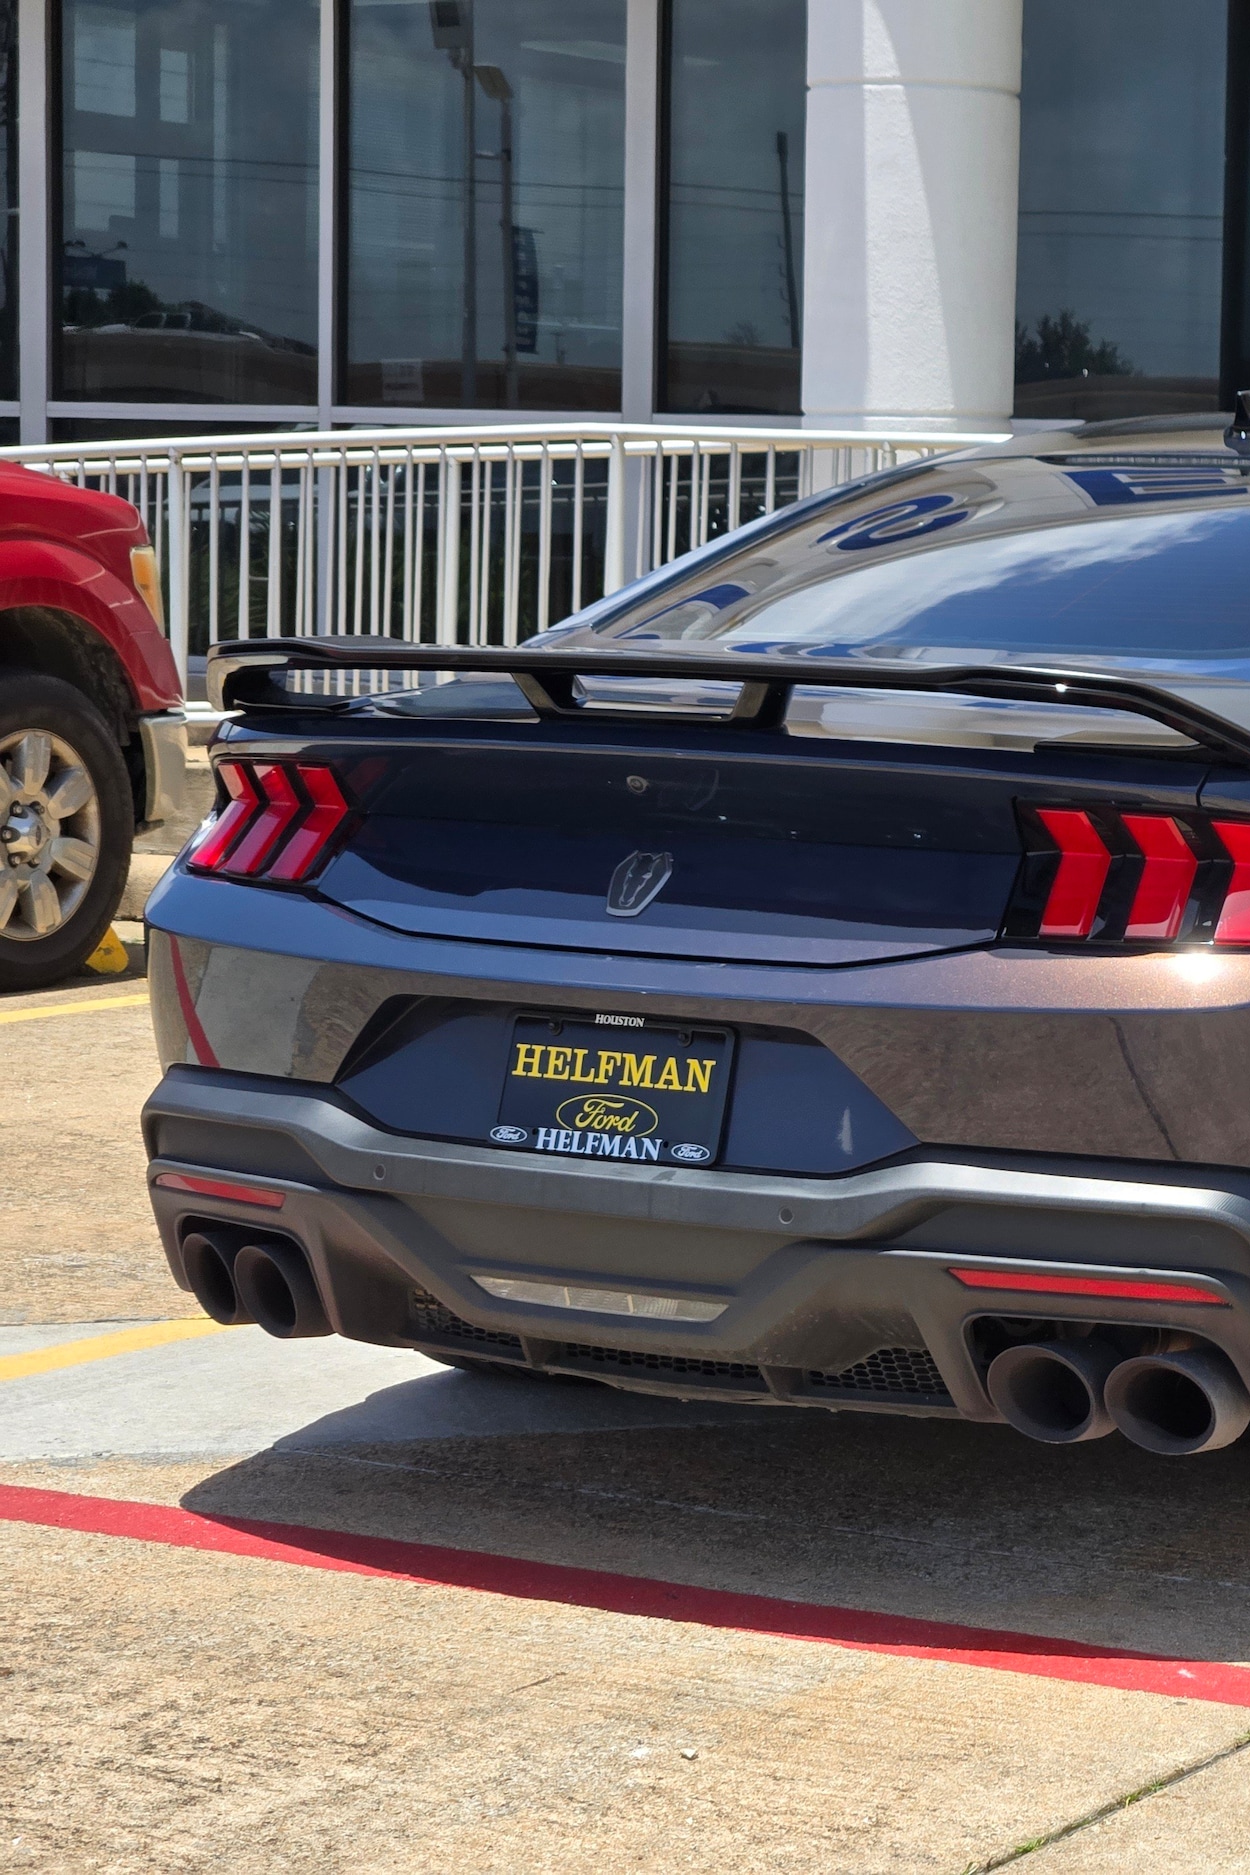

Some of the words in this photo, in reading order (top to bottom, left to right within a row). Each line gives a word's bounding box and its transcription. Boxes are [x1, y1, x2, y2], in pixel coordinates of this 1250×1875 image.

[595, 1013, 646, 1028] HOUSTON
[511, 1042, 717, 1093] HELFMAN
[574, 1097, 640, 1133] Ford
[495, 1127, 521, 1142] Ford
[535, 1126, 663, 1162] HELFMAN
[676, 1145, 705, 1160] Ford
